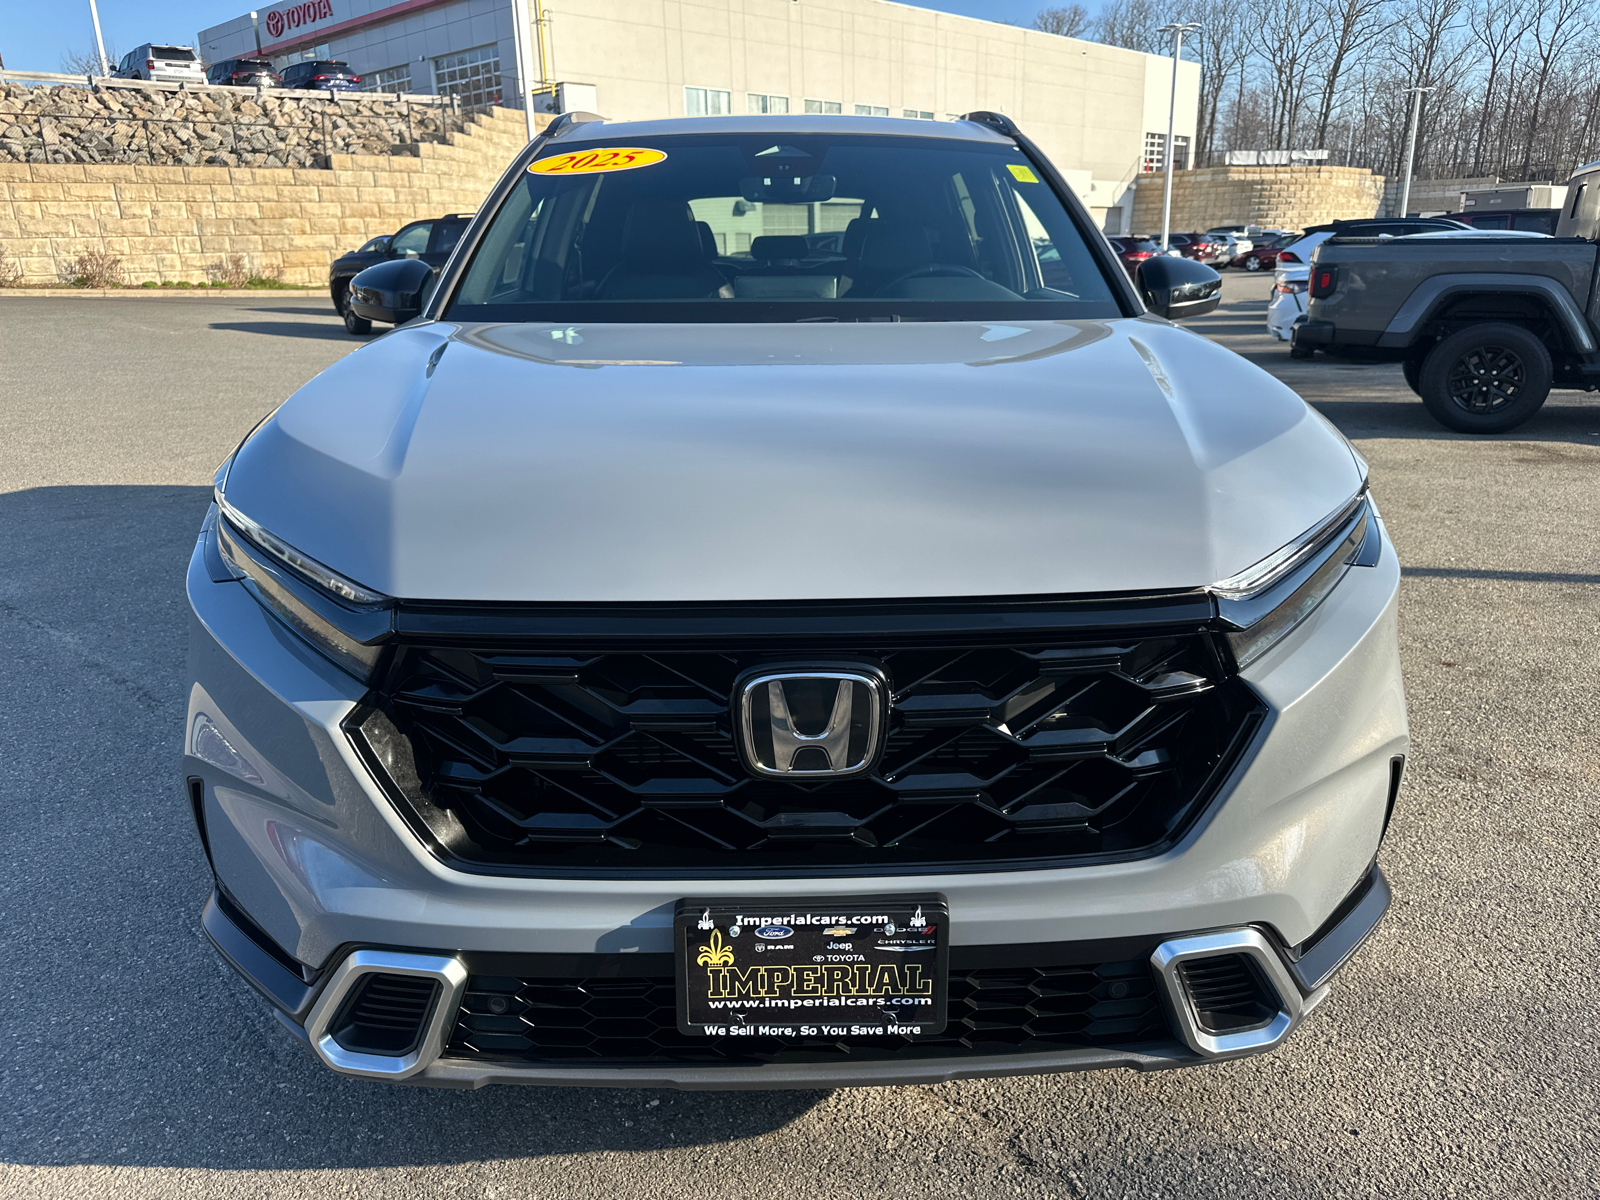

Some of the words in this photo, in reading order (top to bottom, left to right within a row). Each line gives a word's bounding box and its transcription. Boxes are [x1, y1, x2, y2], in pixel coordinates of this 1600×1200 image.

[282, 0, 333, 29] TOYOTA
[546, 151, 645, 172] 2025
[735, 914, 889, 927] Imperialcars.com
[763, 928, 785, 936] Ford
[826, 942, 853, 951] Jeep
[826, 954, 866, 962] TOYOTA
[707, 964, 932, 998] IMPERIAL
[708, 996, 932, 1009] www.imperialcars.com
[704, 1025, 726, 1036] We
[729, 1025, 754, 1036] Sell
[758, 1025, 796, 1037] More,
[800, 1025, 817, 1036] So
[821, 1025, 847, 1035] You
[850, 1025, 883, 1035] Save
[887, 1025, 921, 1035] More
